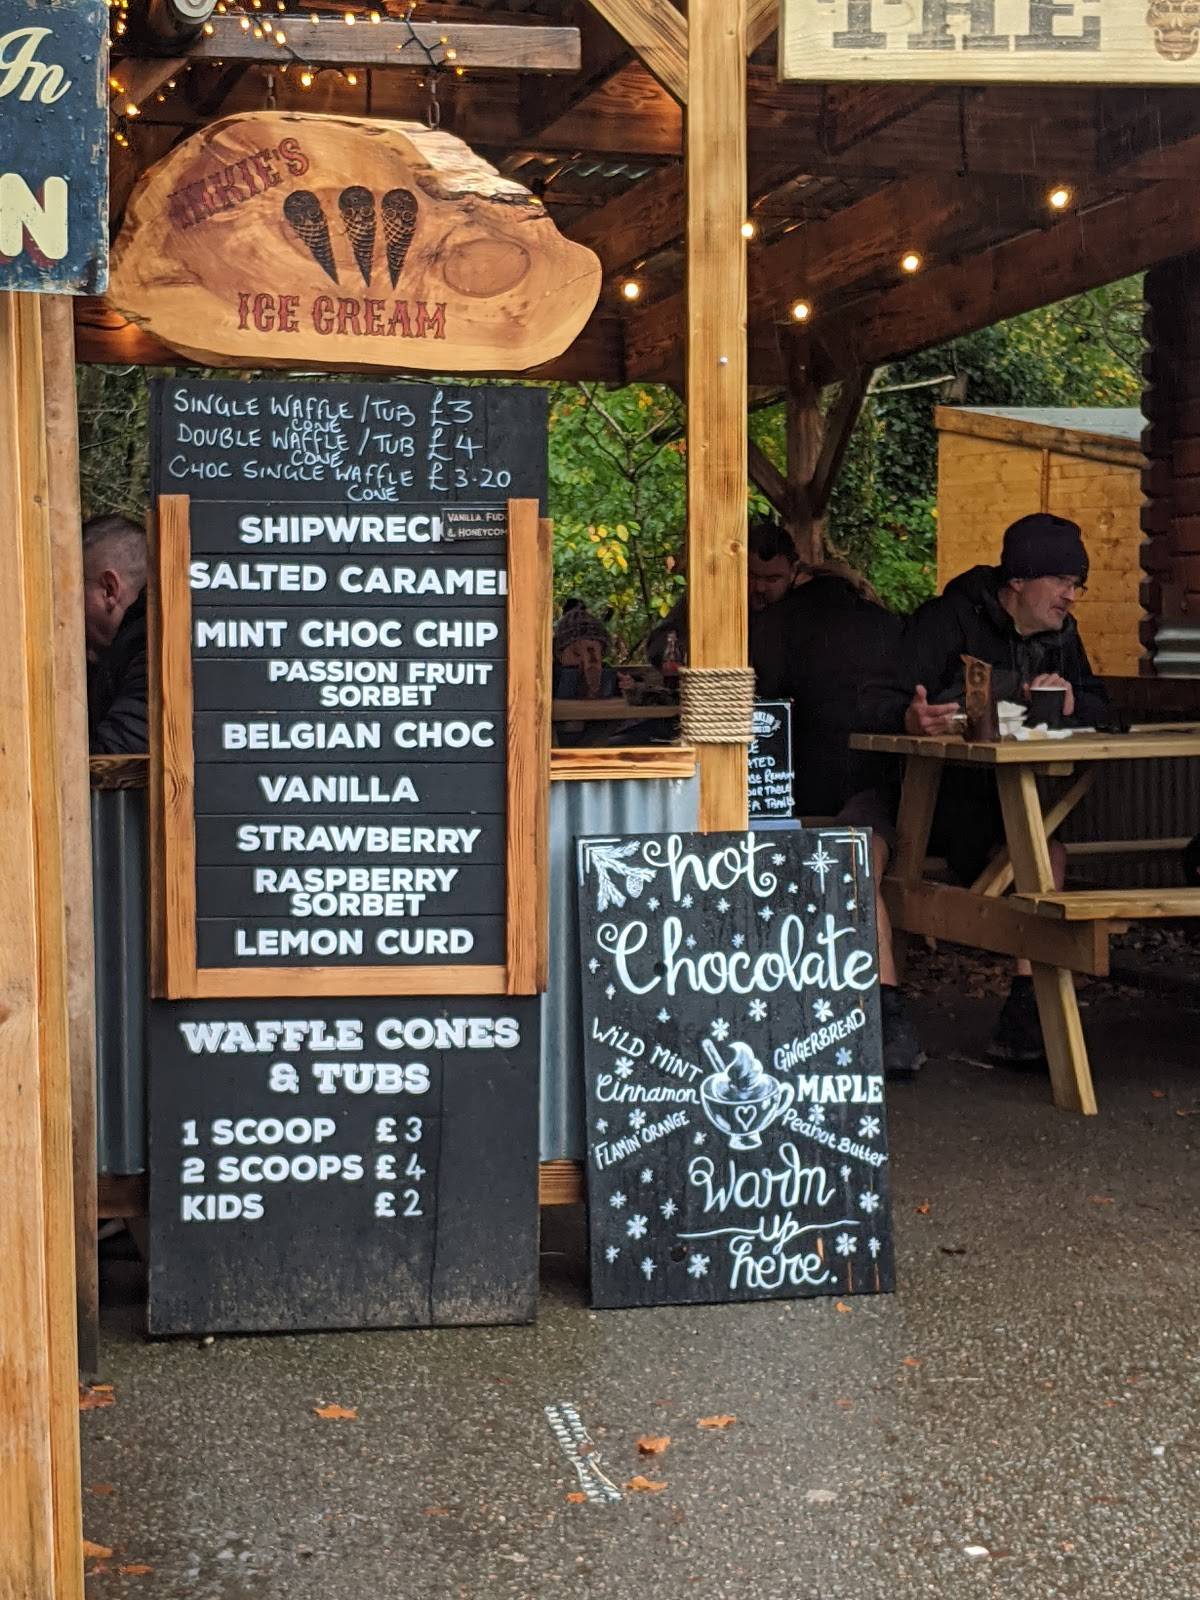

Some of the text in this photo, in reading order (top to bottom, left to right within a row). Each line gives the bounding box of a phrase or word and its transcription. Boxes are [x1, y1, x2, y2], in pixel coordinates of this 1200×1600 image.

[238, 292, 447, 339] ICE CREAM
[174, 388, 260, 417] SINGLE
[271, 394, 354, 420] WAFFLE
[430, 390, 473, 427] £3
[177, 423, 261, 449] DOUBLE
[272, 426, 349, 453] WAFFLE
[292, 418, 341, 433] CONE
[169, 454, 232, 479] CHOC
[244, 460, 324, 481] SINGLE
[336, 463, 413, 488] WAFFLE
[291, 450, 343, 468] CONE
[347, 485, 399, 502] CONE
[485, 512, 507, 523] FUD
[190, 562, 327, 592] SALTED
[196, 620, 499, 648] MINT CHOC CHIP
[269, 661, 493, 685] PASSION FRUIT
[320, 685, 437, 707] SORBET
[223, 721, 495, 750] BELGIAN CHOC
[259, 776, 419, 803] VANILLA
[237, 825, 482, 854] STRAWBERRY
[254, 868, 459, 894] RASPBERRY
[643, 832, 778, 902] hot
[290, 893, 426, 918] SORBET
[235, 929, 474, 956] LEMON CURD
[597, 914, 878, 996] Chocolate
[179, 1017, 520, 1054] WAFFLE CONES
[269, 1062, 431, 1095] & TUBS
[596, 1073, 700, 1104] Cinnamon
[797, 1074, 884, 1103] MAPLE
[182, 1120, 199, 1145] 1
[211, 1118, 336, 1145] SCOOP
[642, 1109, 690, 1143] ORANGE
[782, 1108, 888, 1167] Peanut Butter
[182, 1157, 205, 1184] 2
[217, 1154, 364, 1182] SCOOPS
[688, 1142, 836, 1212] Warm
[181, 1194, 264, 1222] KIDS
[759, 1211, 800, 1255] up
